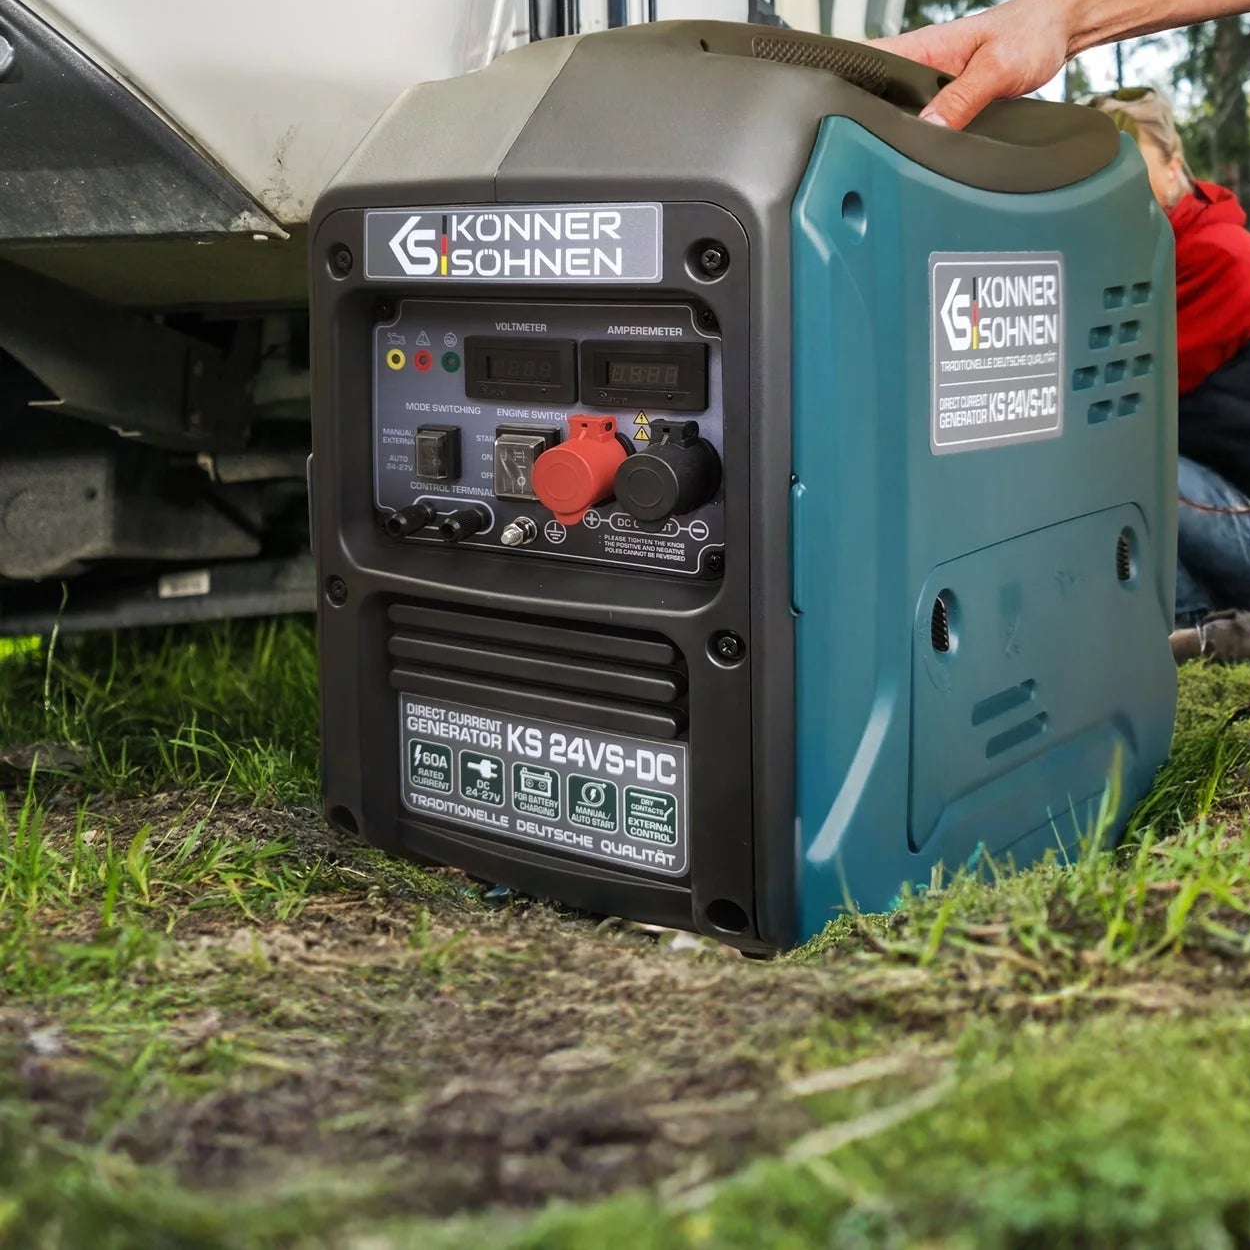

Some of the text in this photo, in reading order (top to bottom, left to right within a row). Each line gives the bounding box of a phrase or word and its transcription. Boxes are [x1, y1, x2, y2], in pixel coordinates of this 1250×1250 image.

[495, 322, 547, 332] VOLTMETER
[607, 325, 683, 336] AMPEREMETER
[940, 357, 992, 372] TRADITIONELLE
[405, 402, 481, 415] MODE SWITCHING
[939, 385, 1057, 428] GENERATOR KS 24VS-DC
[496, 408, 567, 420] ENGINE SWITCH
[383, 437, 415, 445] EXTERNA
[476, 434, 495, 443] STAR
[389, 454, 409, 462] AUTO
[481, 453, 493, 461] ON
[410, 481, 495, 497] CONTROL TERMINAL
[617, 517, 632, 528] DC
[604, 534, 626, 542] PLEASE
[628, 537, 653, 545] TIGHTEN
[616, 542, 641, 550] POSITIVE
[407, 702, 502, 733] DIRECT CURRENT
[406, 716, 676, 786] GENERATOR KS 24VS-DC
[422, 751, 449, 769] 60A
[417, 767, 445, 781] RATED
[412, 775, 450, 791] CURRENT
[476, 779, 490, 790] DC
[465, 786, 501, 803] 24-27V
[514, 791, 559, 809] FOR BATTERY
[519, 801, 556, 817] CHARGING
[640, 798, 654, 806] DRY
[631, 803, 664, 816] CONTACTS
[571, 814, 615, 830] AUTO START
[628, 816, 674, 834] EXTERNAL
[410, 792, 676, 867] TRADITIONELLE DEUTSCHE QUALITÄT
[630, 827, 673, 843] CONTROL
